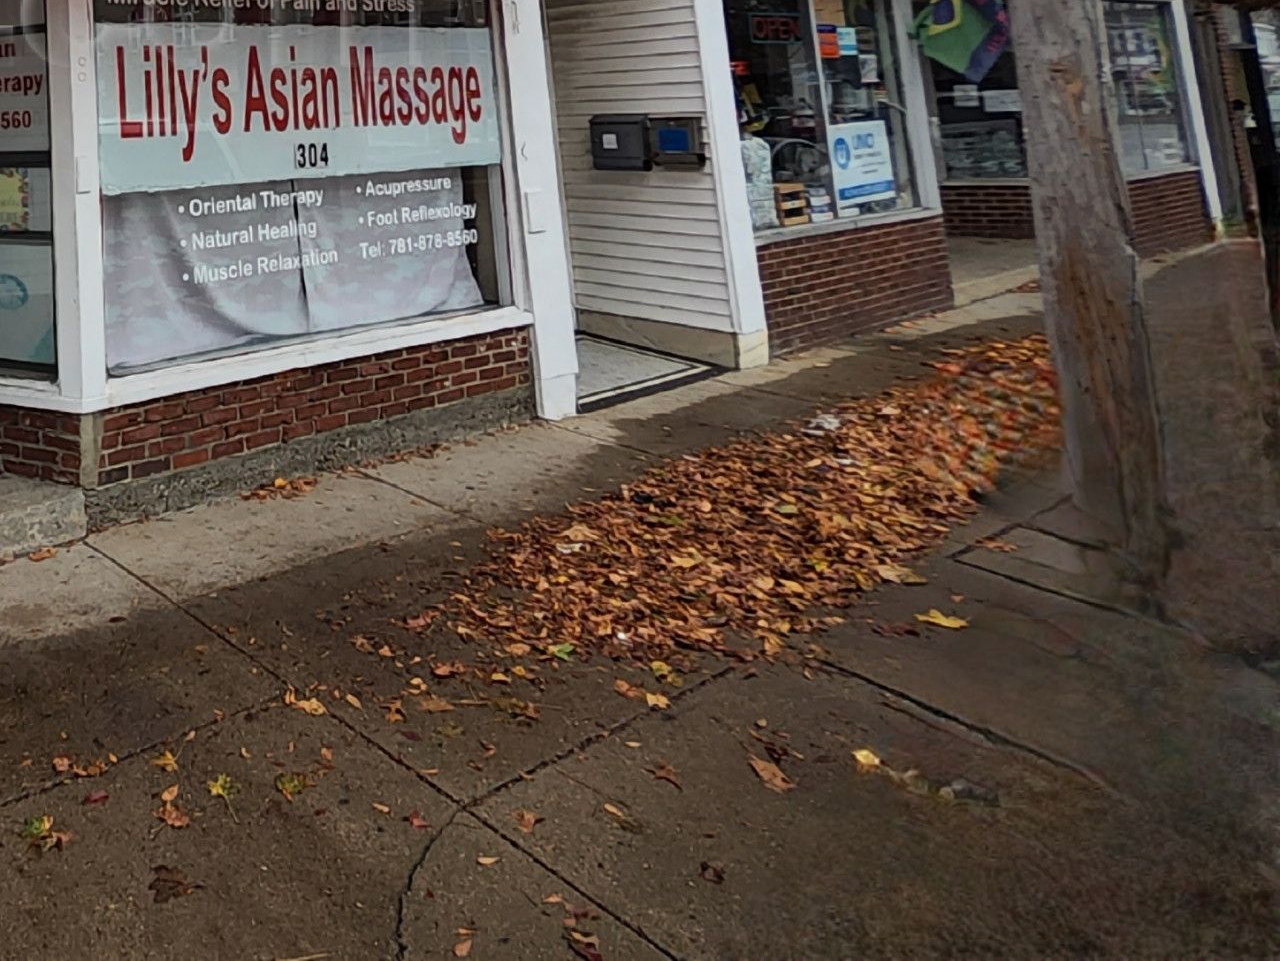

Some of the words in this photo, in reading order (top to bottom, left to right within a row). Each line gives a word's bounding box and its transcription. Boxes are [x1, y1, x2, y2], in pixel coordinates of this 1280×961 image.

[752, 17, 801, 39] OPEN
[116, 45, 233, 162] Lilly's
[243, 44, 340, 133] Asian
[349, 45, 483, 145] Massage
[296, 143, 328, 169] 304
[365, 177, 452, 198] Acupressure
[189, 193, 256, 216] Oriental
[259, 189, 324, 208] Therapy
[367, 208, 399, 227] Foot
[401, 202, 477, 224] Reflexology
[191, 225, 253, 251] Natural
[257, 219, 317, 242] Healing
[359, 241, 386, 259] Tel:
[388, 229, 478, 255] 781-878-8560
[193, 259, 253, 285] Muscle
[257, 249, 339, 275] Relaxation
